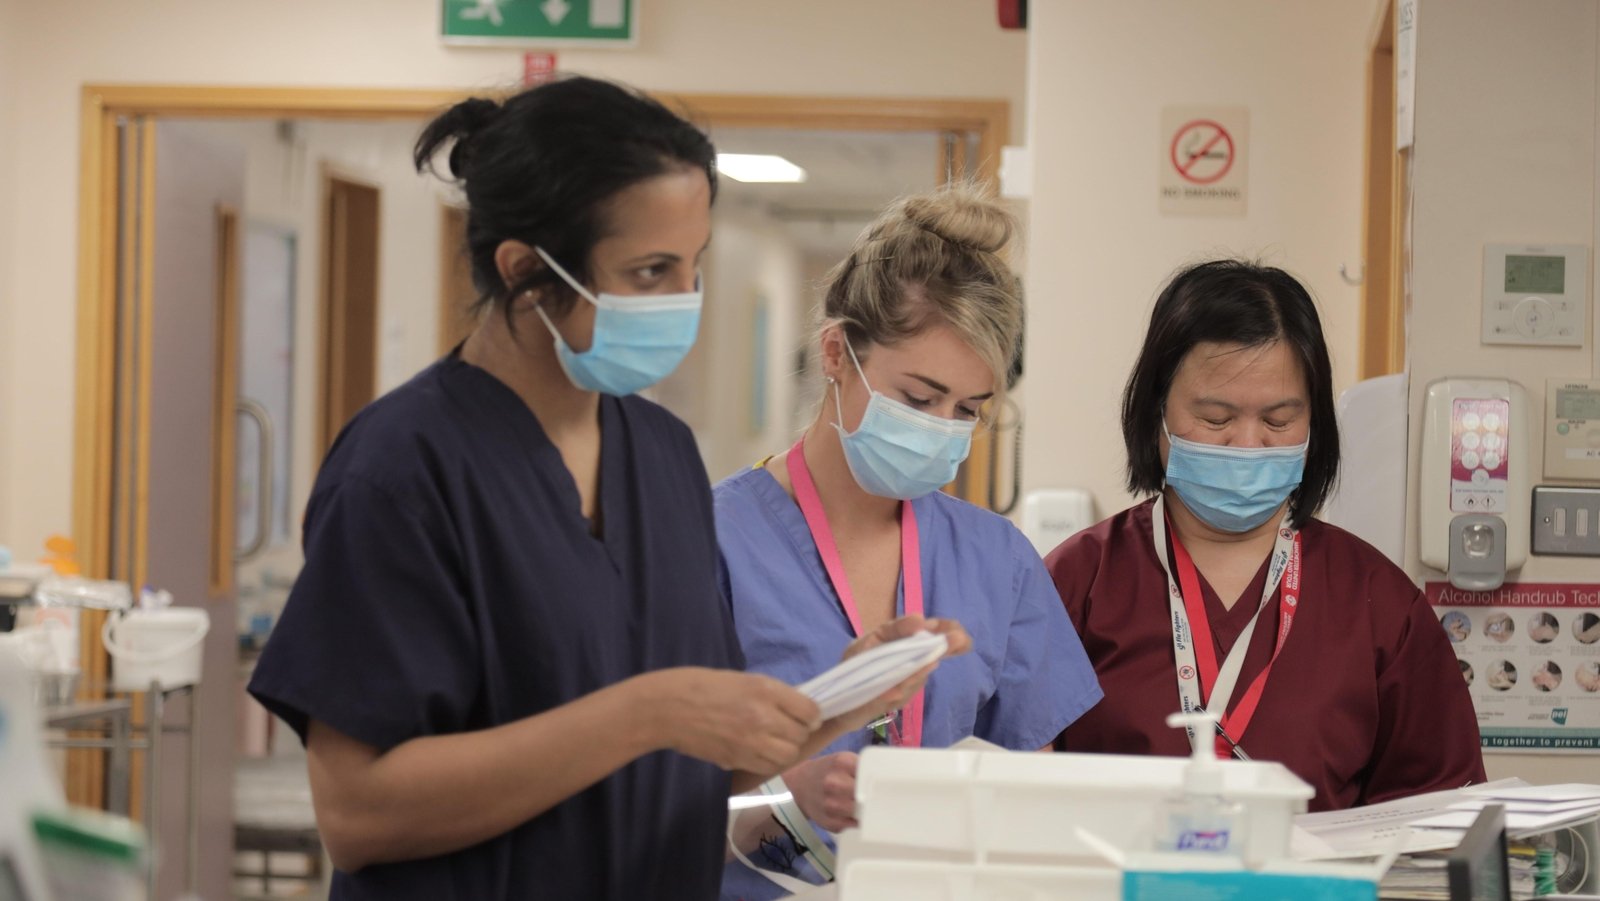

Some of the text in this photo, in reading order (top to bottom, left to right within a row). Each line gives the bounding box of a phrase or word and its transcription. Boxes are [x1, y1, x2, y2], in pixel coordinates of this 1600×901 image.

[1438, 590, 1494, 603] Alcohol
[1500, 589, 1566, 604] Handrub
[1493, 737, 1536, 747] together
[1540, 738, 1550, 747] to
[1555, 738, 1593, 748] prevent
